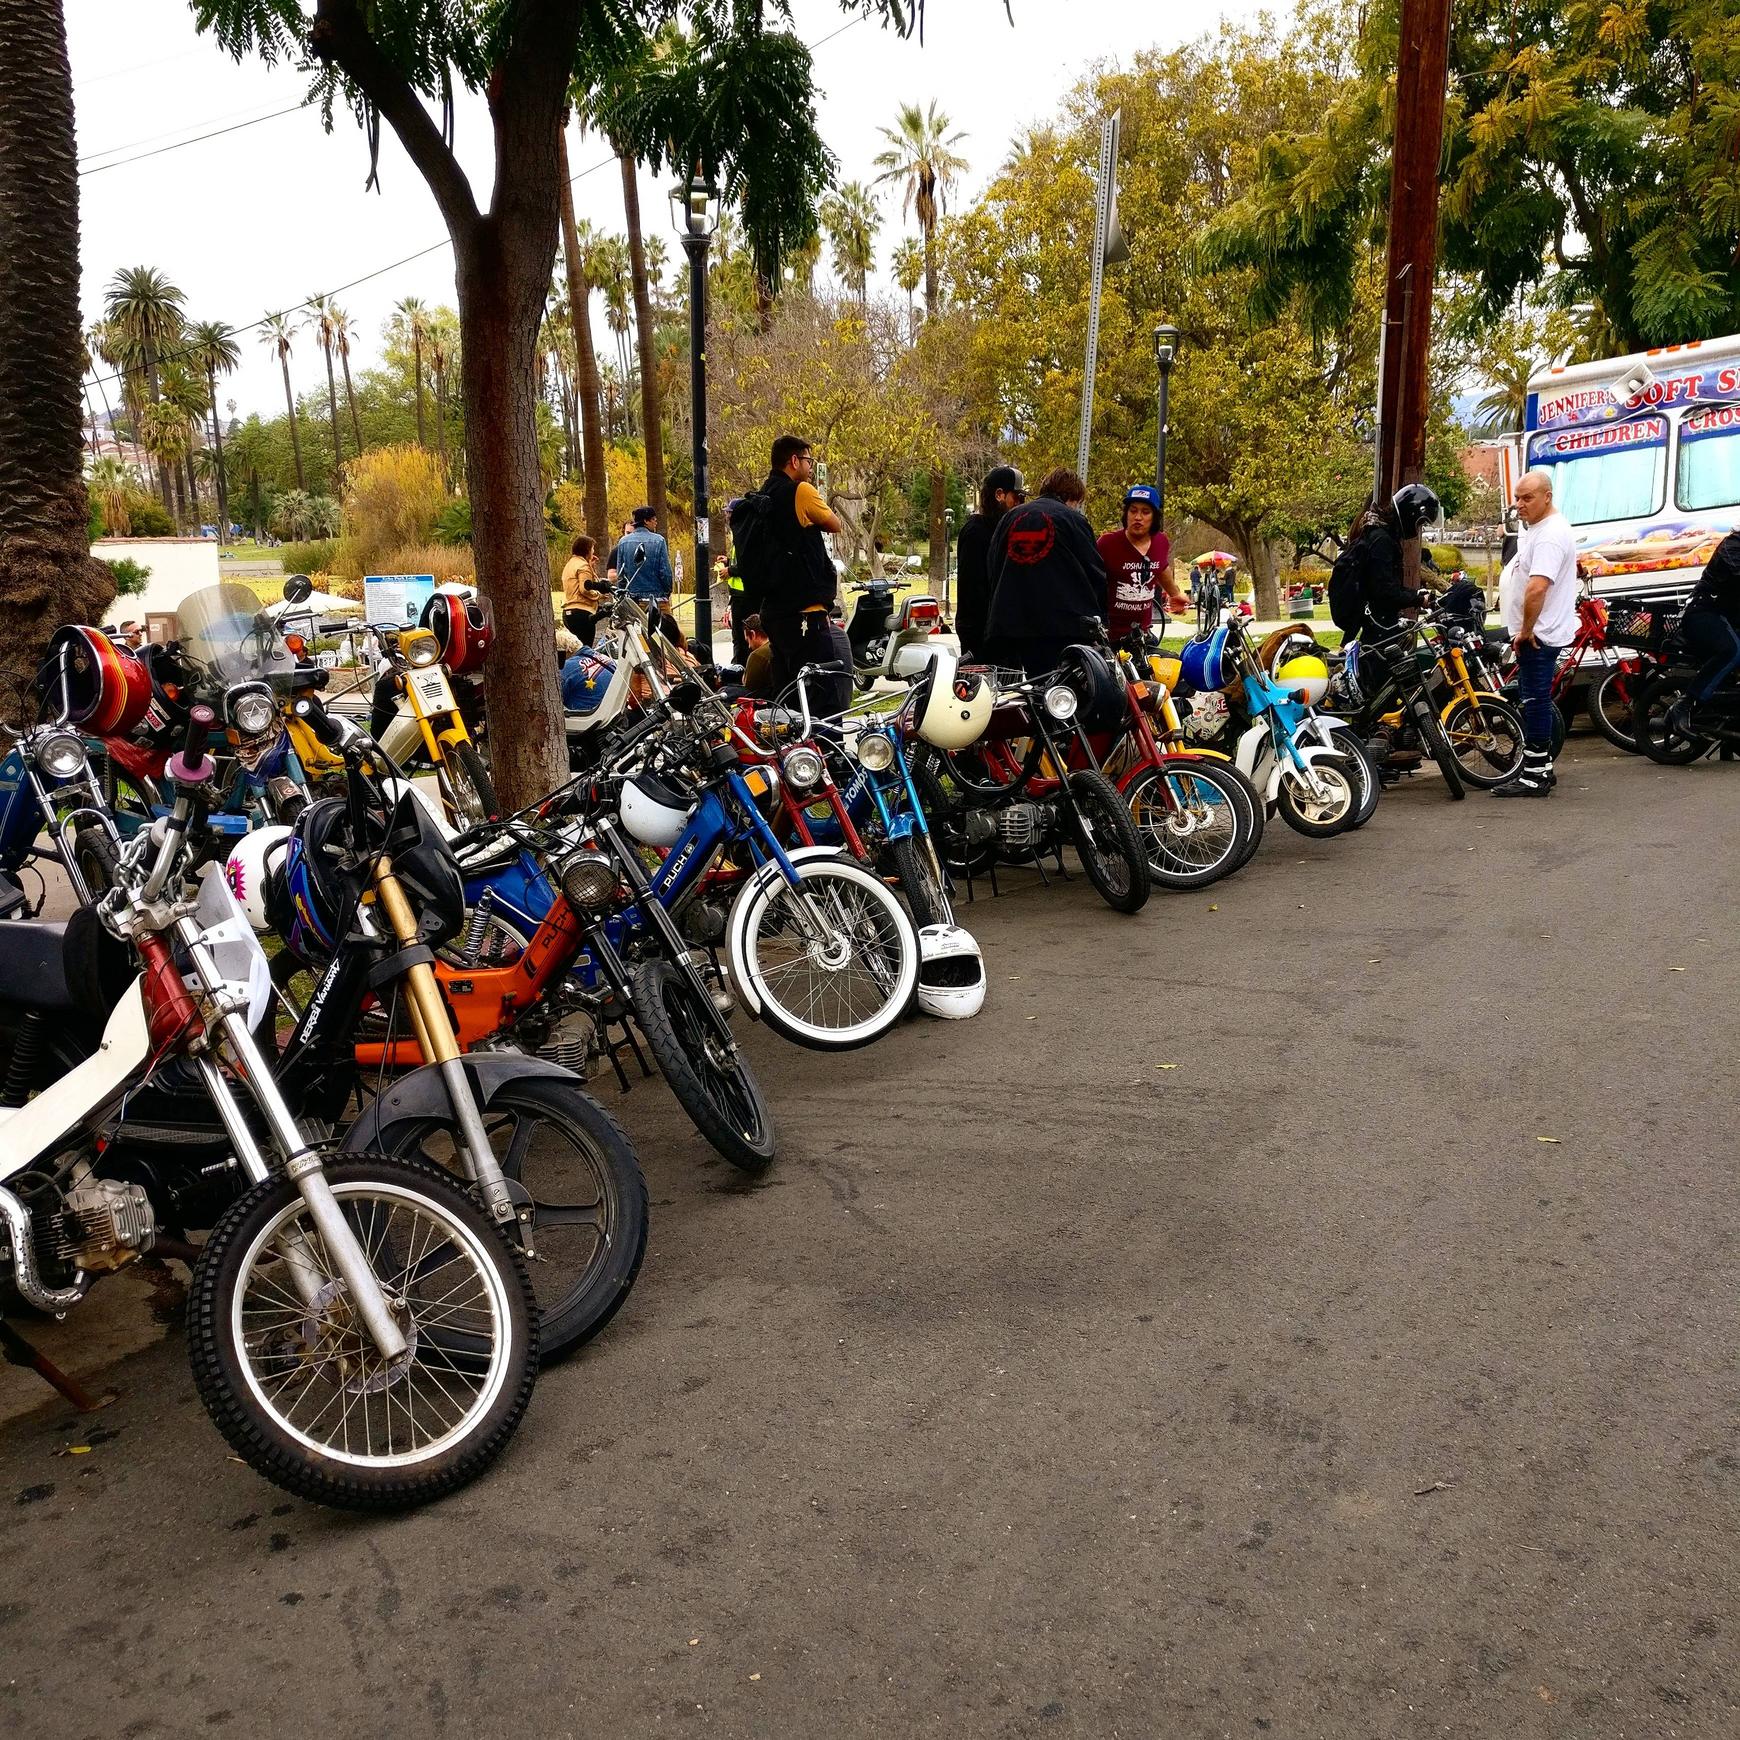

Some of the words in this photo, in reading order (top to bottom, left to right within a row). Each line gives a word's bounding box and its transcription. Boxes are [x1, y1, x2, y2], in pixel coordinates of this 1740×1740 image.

[1717, 368, 1740, 393] S
[1555, 419, 1662, 451] CHILDREN
[845, 767, 868, 803] TOMOS
[664, 854, 687, 887] PUCH
[542, 906, 571, 949] PUCH
[315, 958, 340, 1004] Variant
